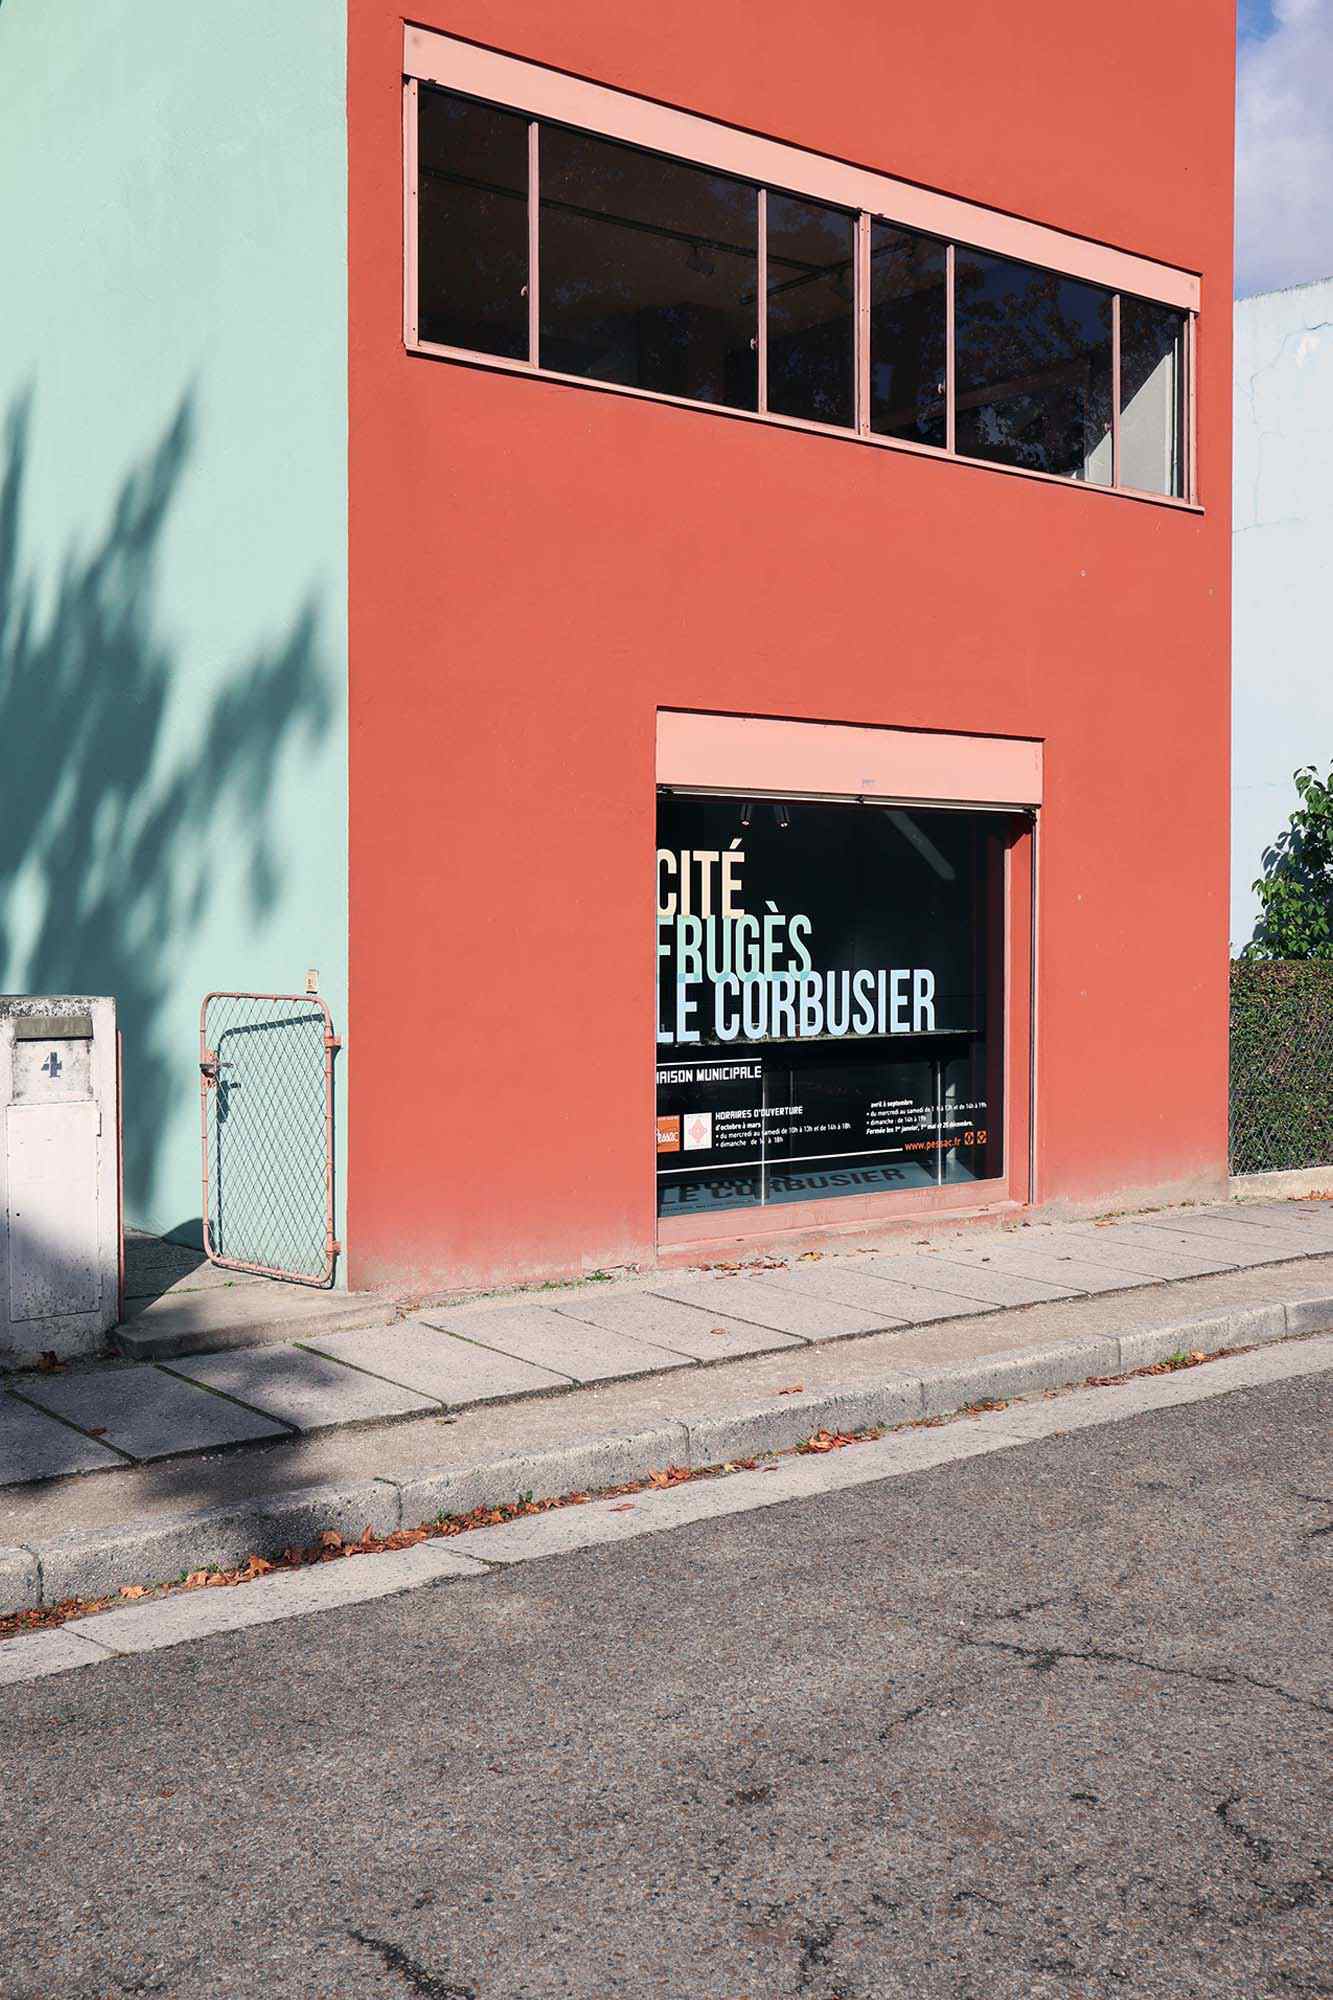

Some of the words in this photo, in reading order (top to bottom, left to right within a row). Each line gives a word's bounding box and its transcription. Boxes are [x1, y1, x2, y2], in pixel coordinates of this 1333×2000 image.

[656, 838, 745, 920] CITÉ
[656, 900, 813, 984] FRUGÈS
[656, 971, 701, 1043] LE
[715, 968, 936, 1042] CORBUSIER
[41, 1051, 62, 1079] 4
[696, 1065, 762, 1082] MUNICIPALE
[715, 1110, 752, 1120] HORAIRES
[753, 1106, 803, 1118] D'OUVERTURE
[720, 1139, 746, 1148] dimanche
[728, 1130, 752, 1138] mercredi
